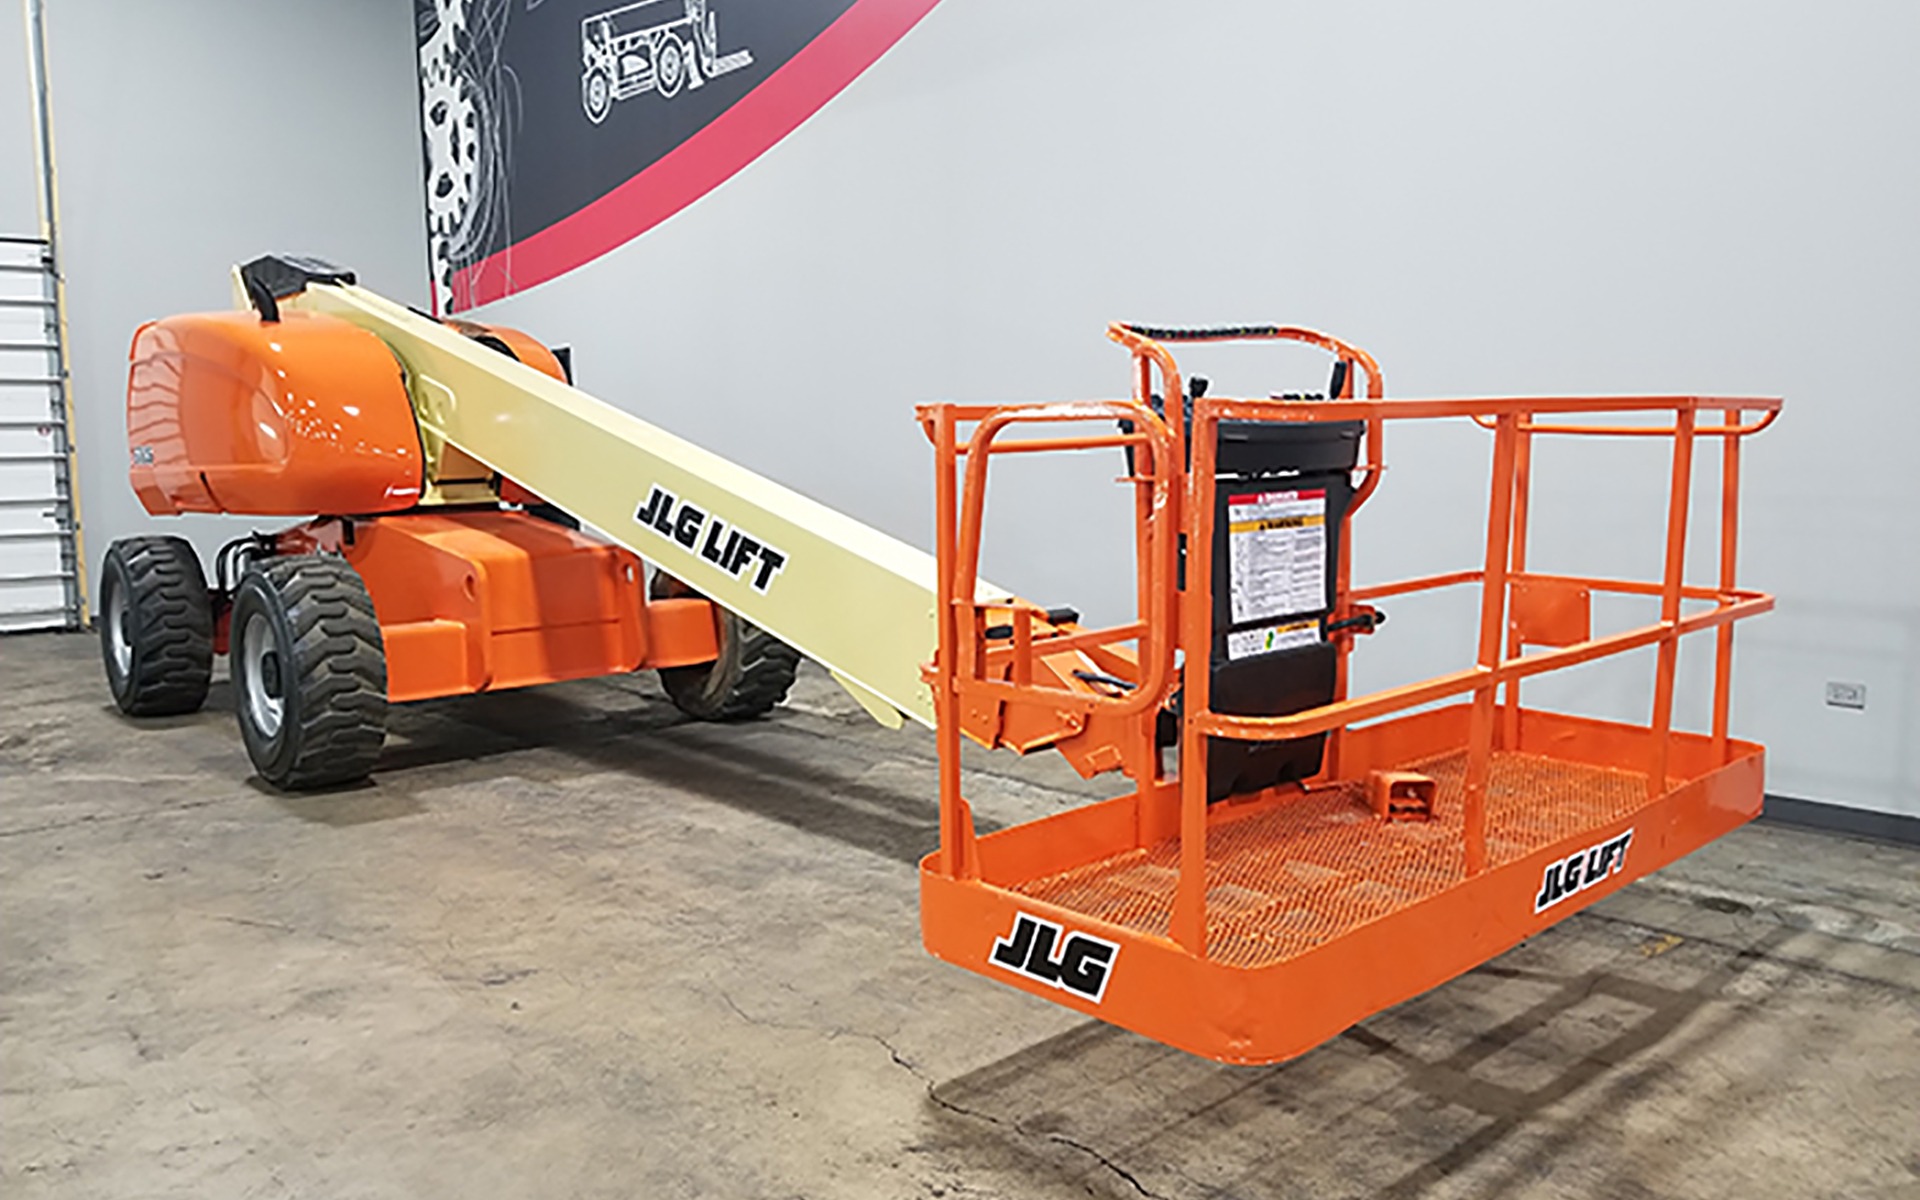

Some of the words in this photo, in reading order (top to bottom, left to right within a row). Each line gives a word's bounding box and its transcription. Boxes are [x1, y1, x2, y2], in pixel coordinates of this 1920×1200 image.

[636, 487, 705, 549] JLG
[700, 519, 786, 591] LIFT
[1536, 853, 1585, 908] JLG
[1582, 831, 1633, 885] LIFT
[993, 916, 1114, 997] JLG
